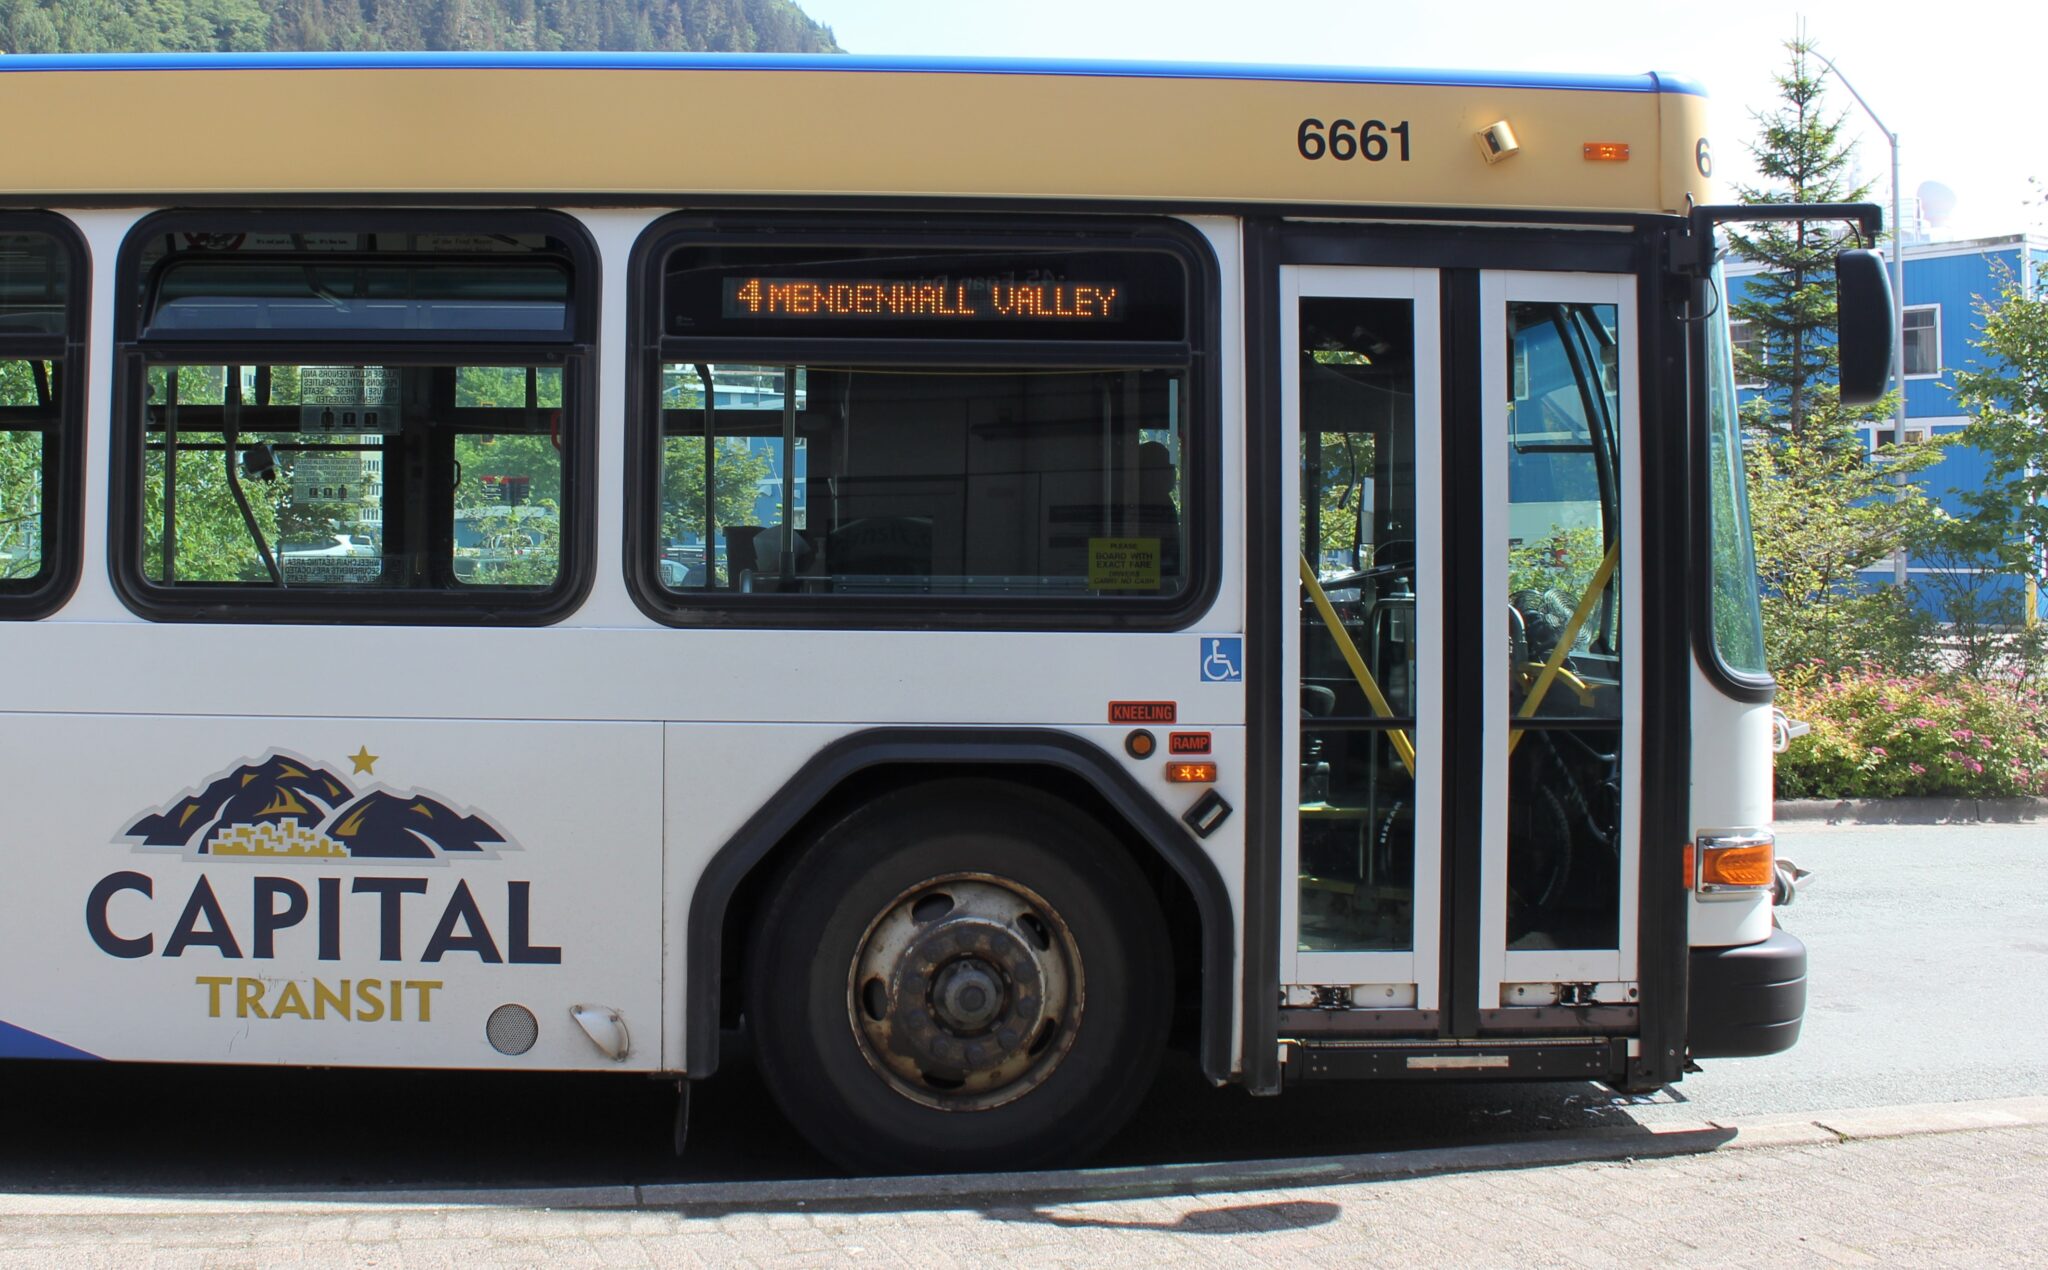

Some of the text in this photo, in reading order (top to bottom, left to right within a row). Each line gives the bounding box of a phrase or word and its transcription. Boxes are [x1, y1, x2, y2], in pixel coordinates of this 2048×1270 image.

[1297, 118, 1411, 162] 6661
[1695, 137, 1713, 178] 6
[738, 278, 1117, 317] 4 MENDENHALL VALLEY
[1095, 551, 1153, 560] BOARD WITH
[1110, 542, 1137, 550] PLEASE
[1095, 560, 1153, 569] EXACT FARE
[1114, 706, 1172, 720] KNEELING
[1173, 737, 1208, 749] RAMP
[85, 870, 562, 965] CAPITAL
[195, 975, 443, 1023] TRANSIT
